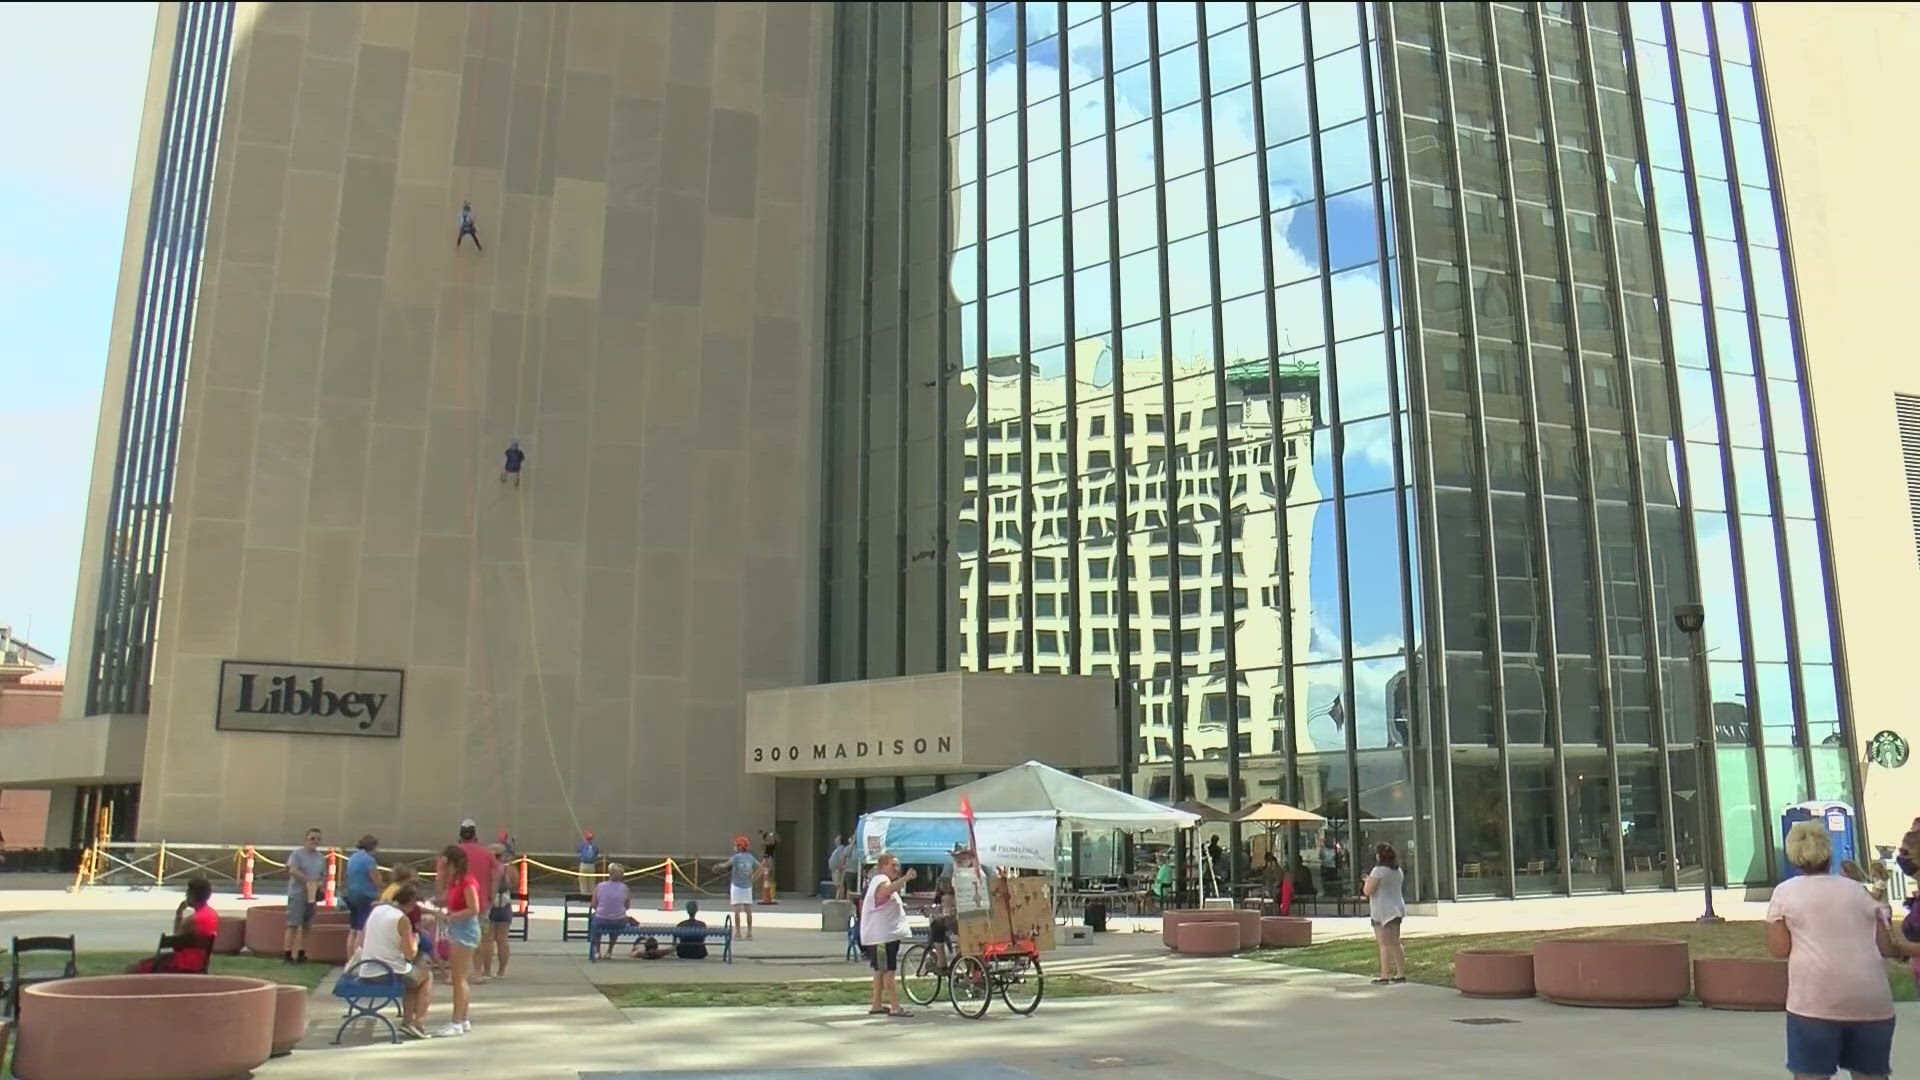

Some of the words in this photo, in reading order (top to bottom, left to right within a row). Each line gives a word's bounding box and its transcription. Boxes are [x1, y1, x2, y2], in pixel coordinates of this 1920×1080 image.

[235, 674, 388, 730] Libbey
[754, 746, 799, 762] 300
[813, 737, 951, 760] MADISON
